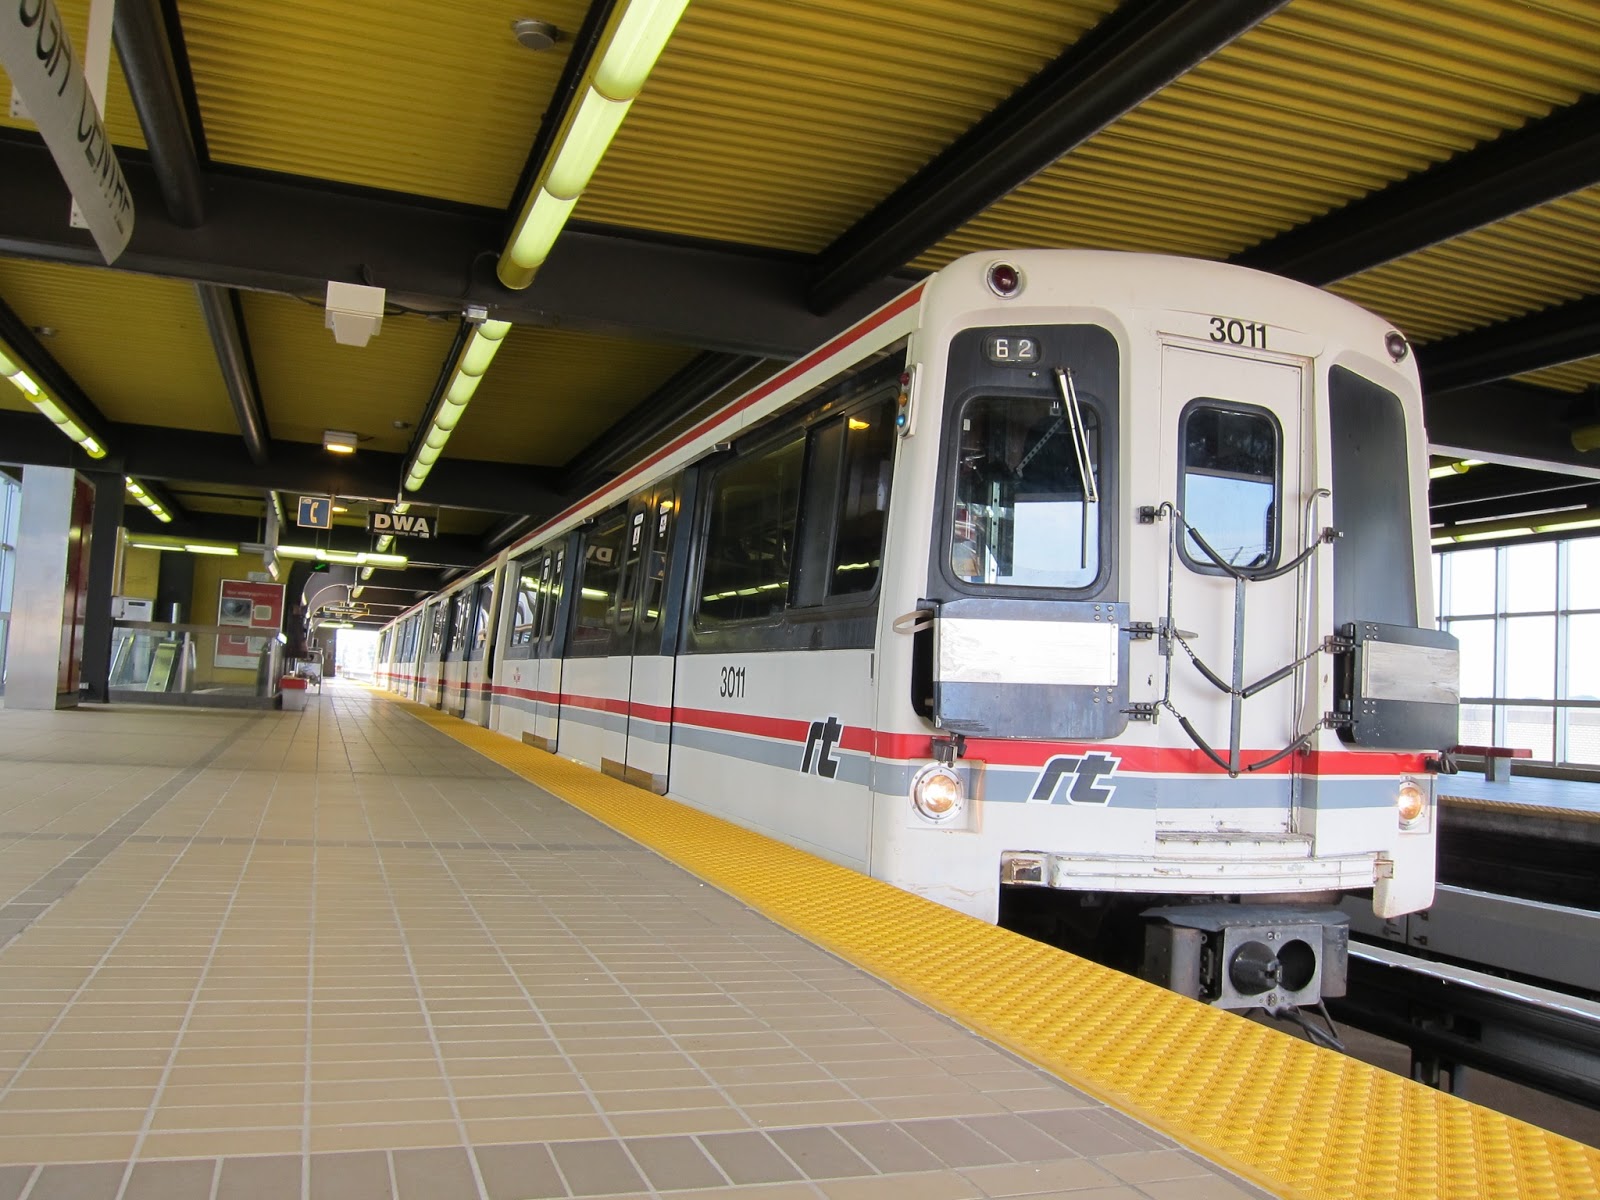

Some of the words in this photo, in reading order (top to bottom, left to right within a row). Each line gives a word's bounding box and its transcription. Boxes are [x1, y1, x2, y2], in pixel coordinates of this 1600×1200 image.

[1209, 316, 1267, 349] 3011
[373, 513, 430, 533] DWA
[719, 666, 746, 698] 3011
[800, 715, 844, 780] rt
[1029, 752, 1120, 806] rt
